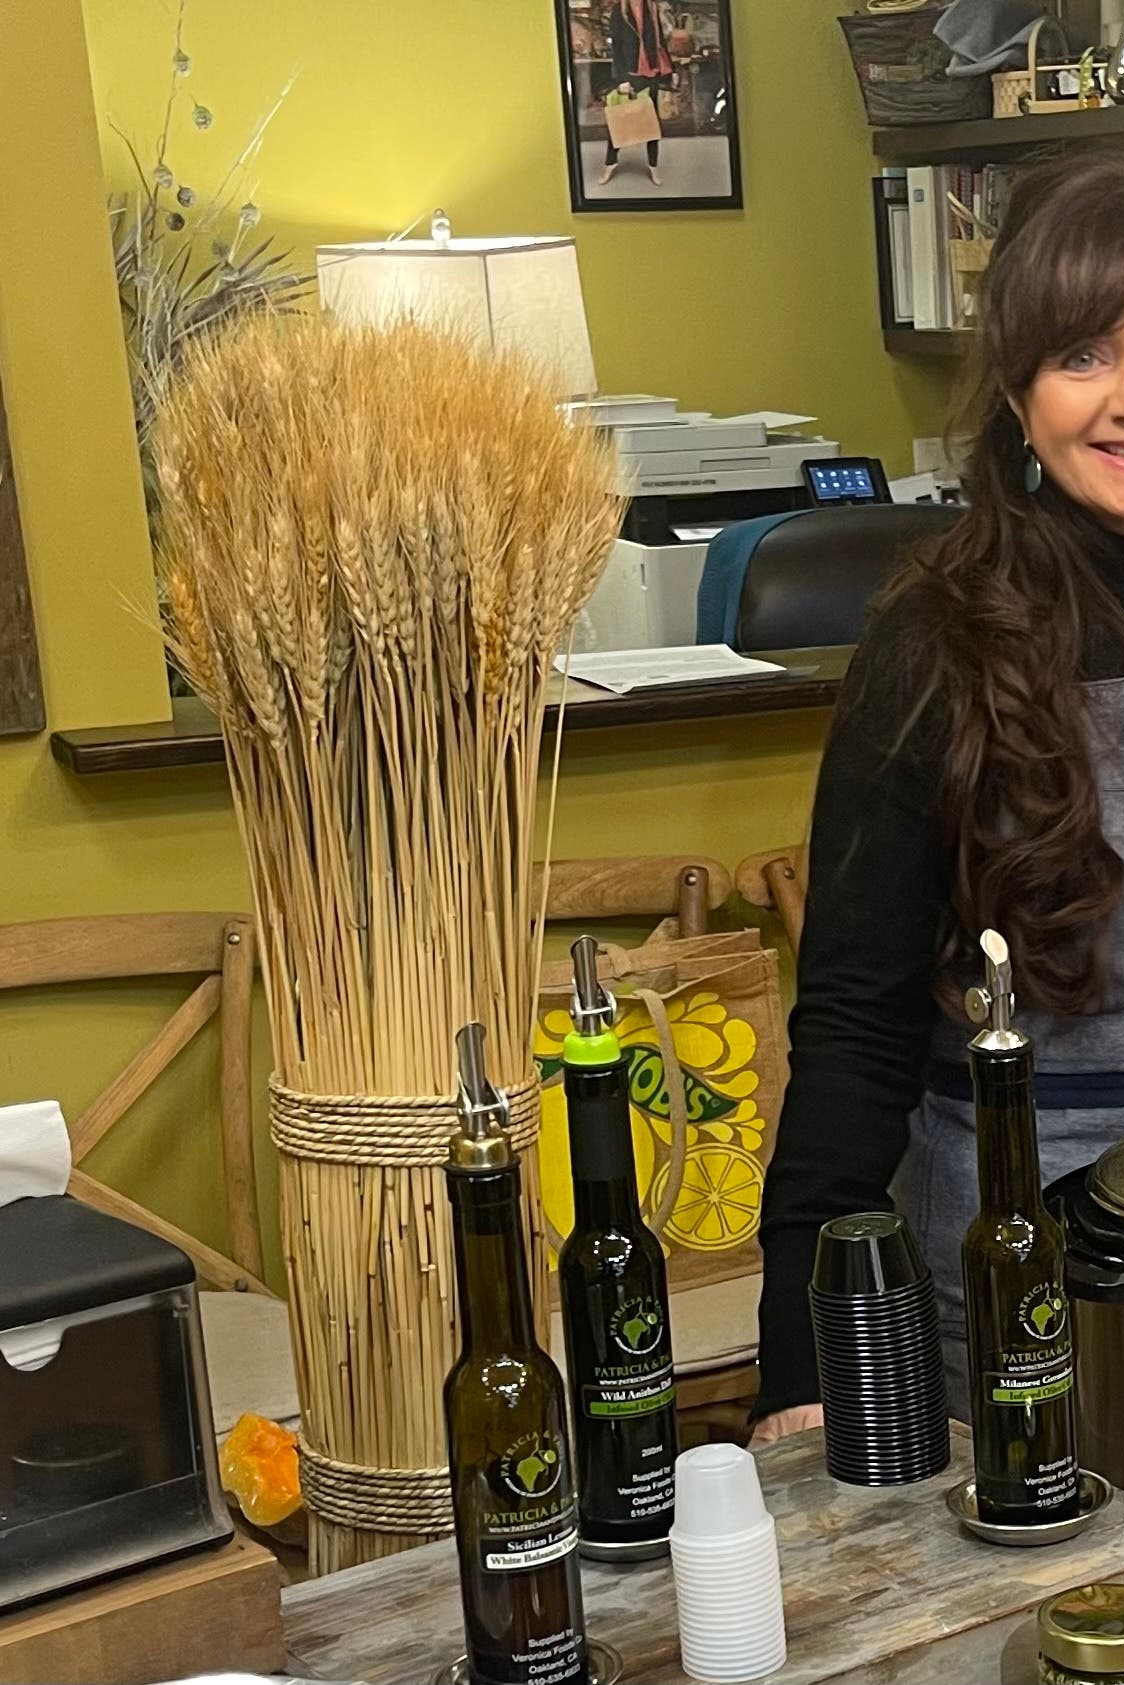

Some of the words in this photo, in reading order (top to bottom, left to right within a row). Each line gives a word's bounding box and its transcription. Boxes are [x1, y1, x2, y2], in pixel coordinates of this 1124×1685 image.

[1018, 1282, 1050, 1322] PATRICIA
[1002, 1348, 1056, 1364] PATRICIA
[594, 1362, 651, 1378] PATRICIA
[651, 1359, 659, 1371] &
[1000, 1378, 1041, 1389] Milanese
[600, 1390, 626, 1402] Wild
[501, 1431, 540, 1478] PATRICIA
[483, 1504, 550, 1525] PATRICIA
[549, 1501, 560, 1514] &
[506, 1537, 548, 1552] Sicilian
[490, 1555, 521, 1565] White
[511, 1650, 553, 1663] Veronica
